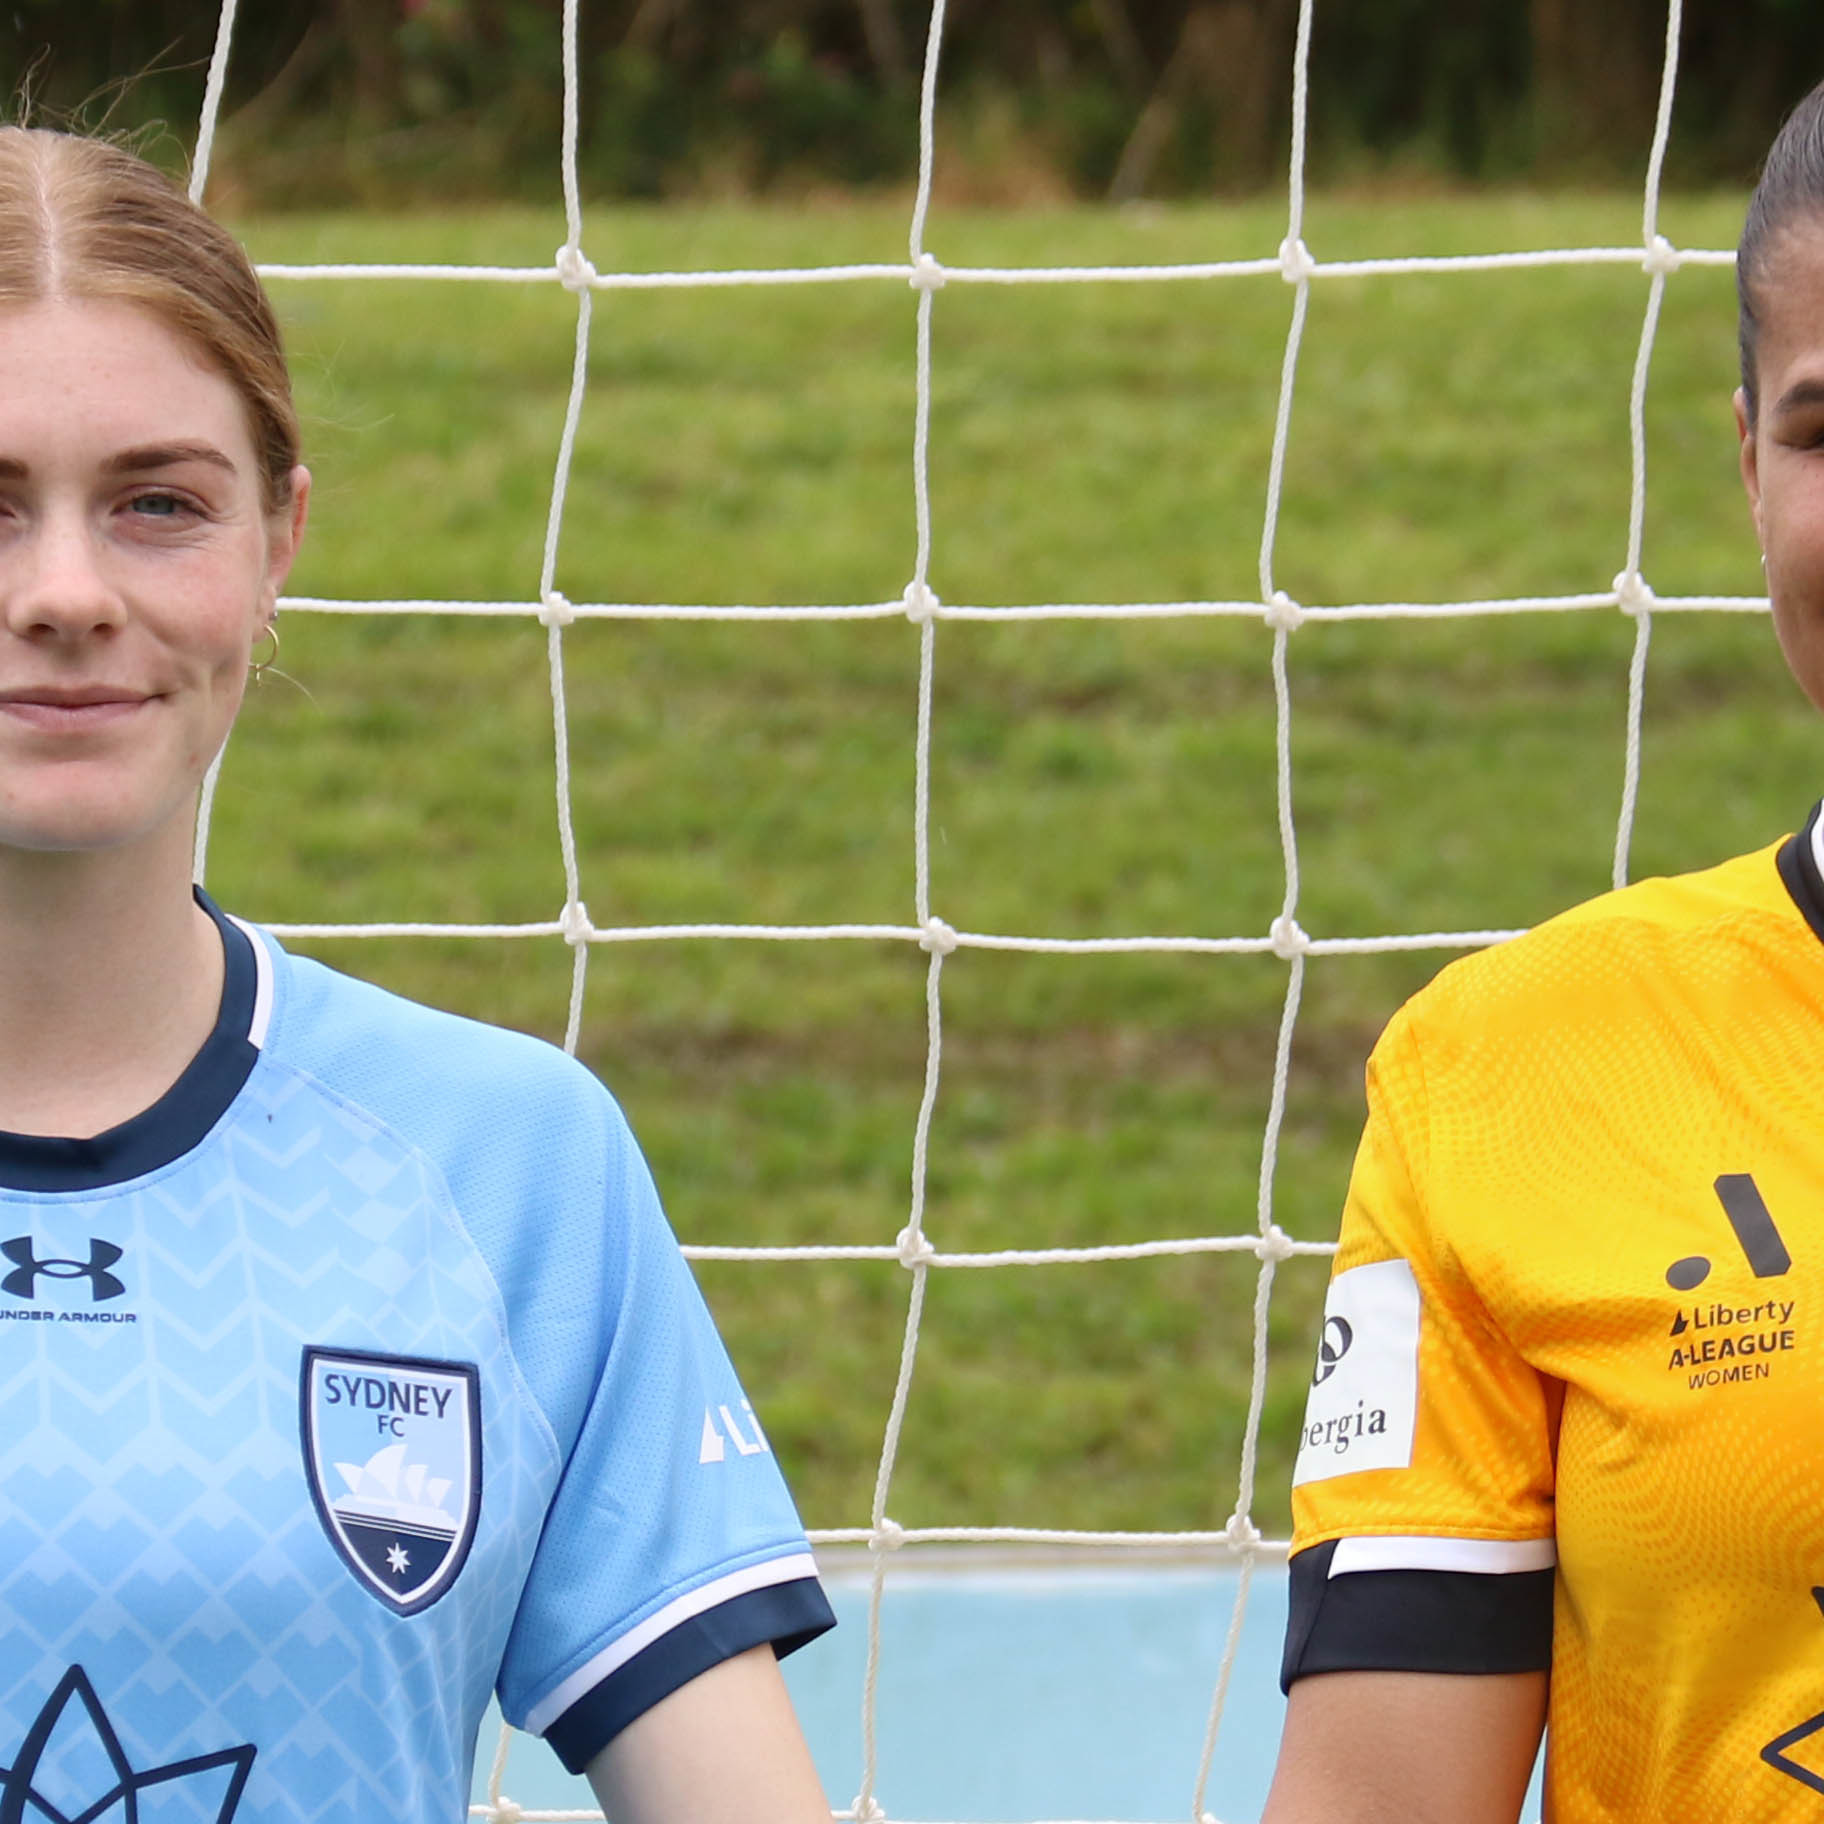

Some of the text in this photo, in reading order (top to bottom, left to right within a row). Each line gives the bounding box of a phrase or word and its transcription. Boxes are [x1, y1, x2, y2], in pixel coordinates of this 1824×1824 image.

[58, 1311, 137, 1323] ARMOUR
[1693, 1300, 1795, 1330] Liberty
[1668, 1330, 1795, 1371] A-LEAGUE
[1688, 1362, 1770, 1390] WOMEN
[324, 1373, 453, 1418] SYDNEY
[377, 1416, 406, 1438] FC
